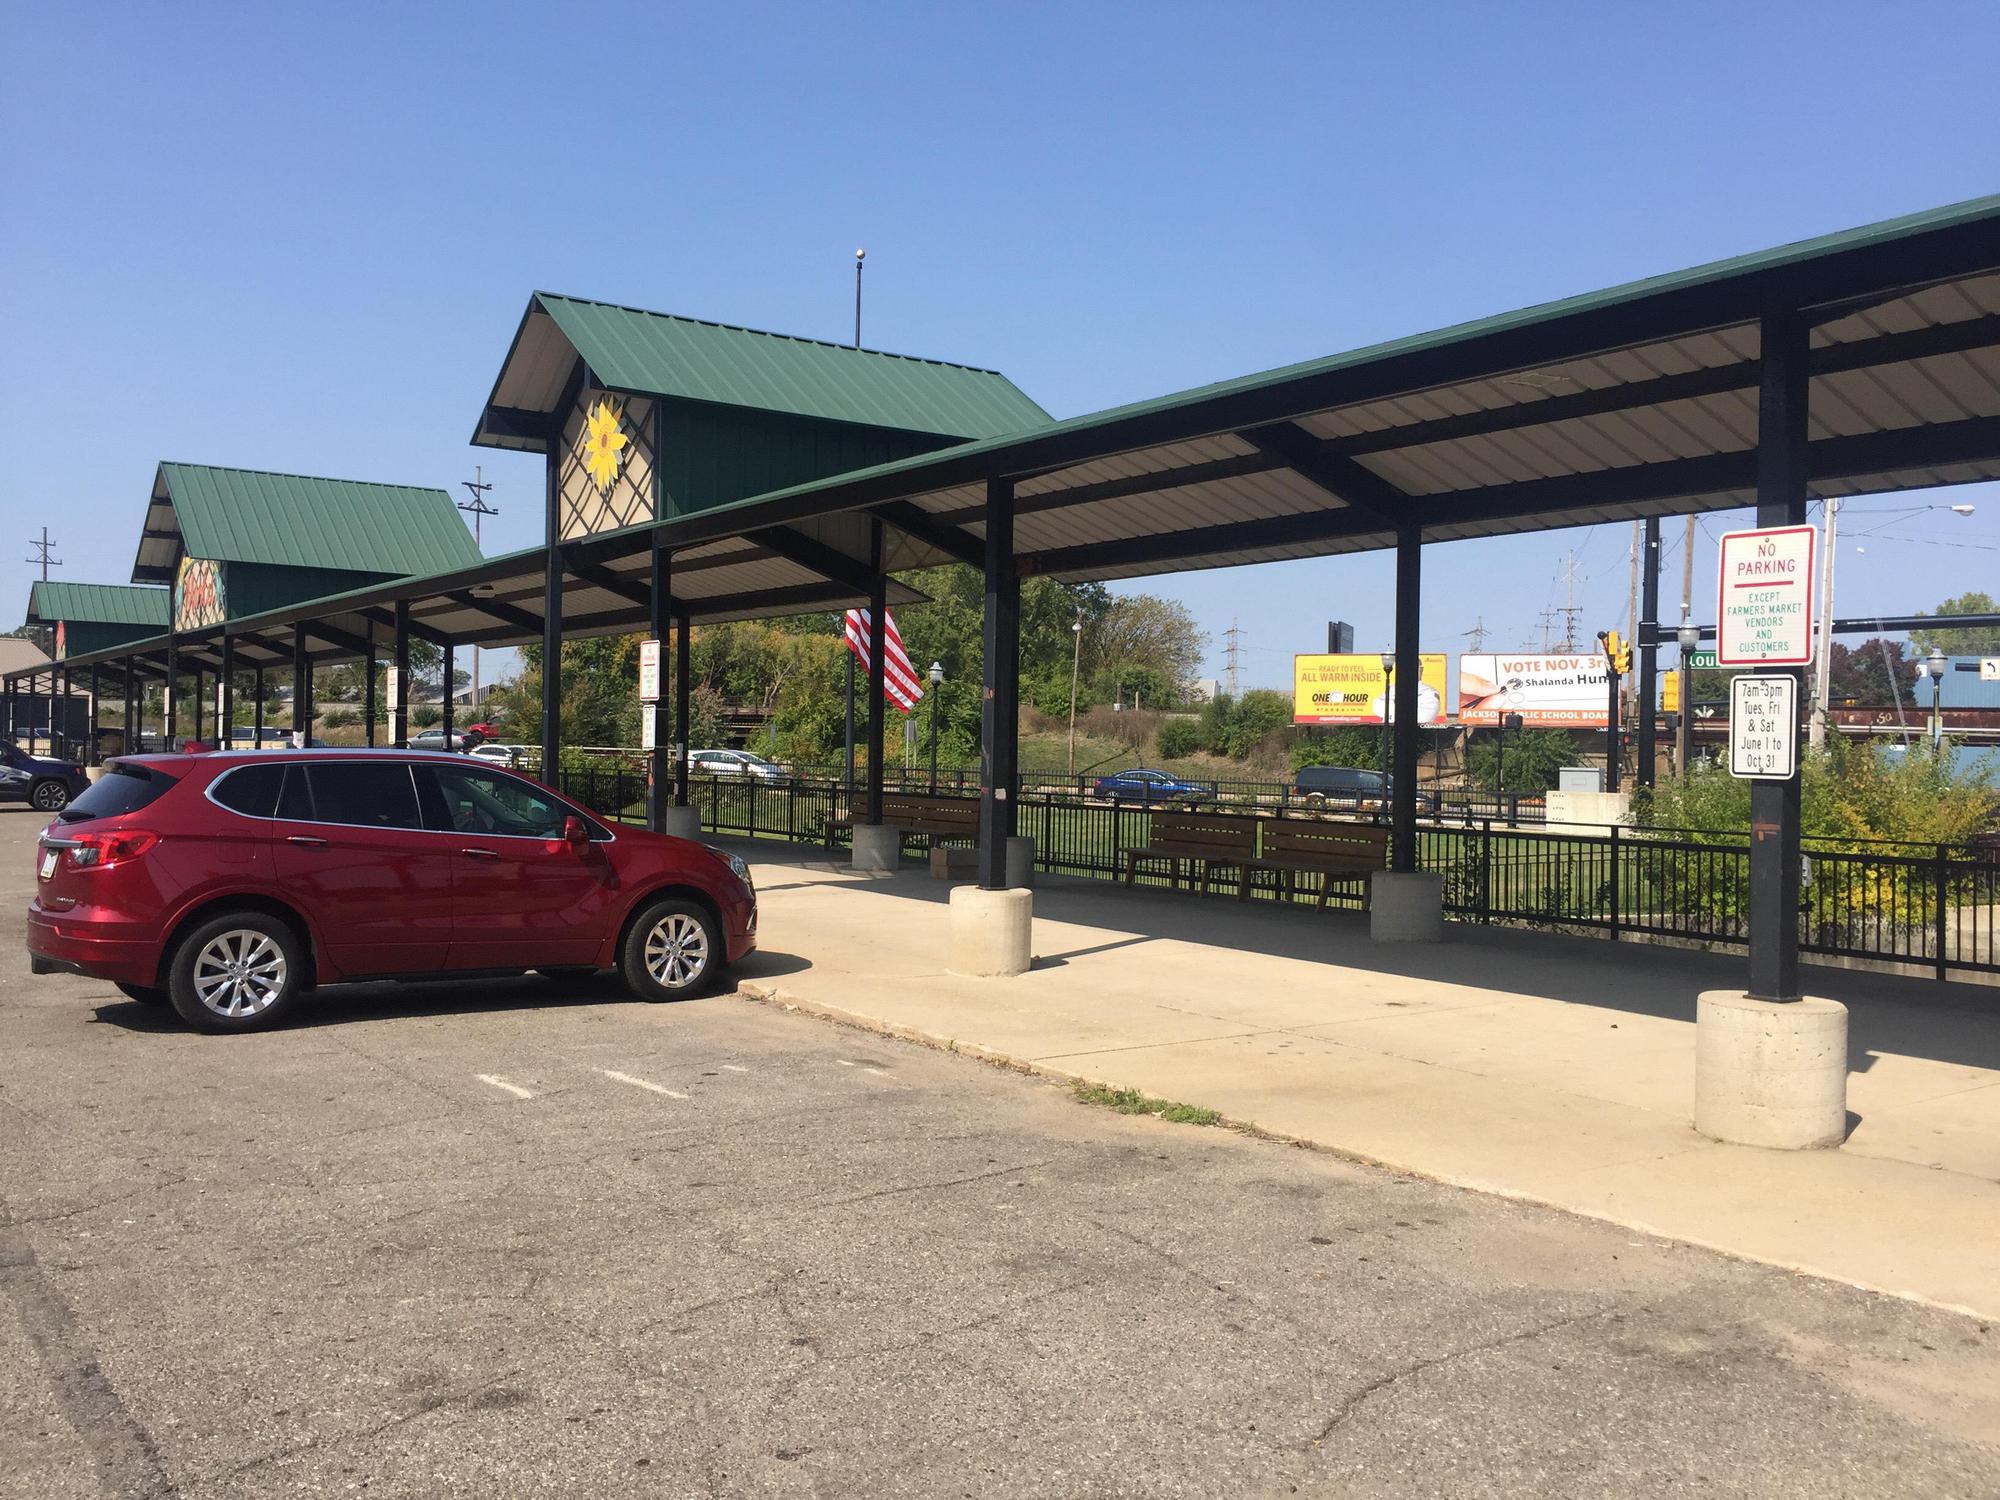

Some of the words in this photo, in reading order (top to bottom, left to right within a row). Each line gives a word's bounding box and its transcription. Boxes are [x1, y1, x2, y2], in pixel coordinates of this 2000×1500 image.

[1758, 543, 1776, 557] NO
[1737, 559, 1796, 576] PARKING
[1748, 592, 1780, 603] EXCEPT
[1727, 605, 1766, 616] FARMERS
[1768, 603, 1801, 614] MARKET
[1745, 616, 1784, 628] VENDORS
[1755, 629, 1773, 640] AND
[1739, 641, 1789, 653] CUSTOMERS
[1503, 661, 1541, 673] VOTE
[1545, 659, 1584, 671] NOV.
[1588, 657, 1607, 669] 3r
[1689, 655, 1720, 667] Lou
[1302, 673, 1317, 682] ALL
[1320, 673, 1349, 682] WARM
[1351, 673, 1381, 682] INSIDE
[1526, 678, 1574, 686] Shalanda
[1577, 674, 1608, 684] Hun
[1312, 693, 1331, 702] ONE
[1343, 693, 1369, 702] HOUR
[1742, 683, 1782, 699] 7am-3pm
[1744, 701, 1765, 716] Tues,
[1769, 701, 1780, 714] Fri
[1748, 718, 1755, 732] &
[1761, 718, 1775, 732] Sat
[1741, 736, 1762, 750] June
[1773, 737, 1782, 750] to
[1747, 754, 1761, 768] Oct
[1766, 754, 1775, 768] 31
